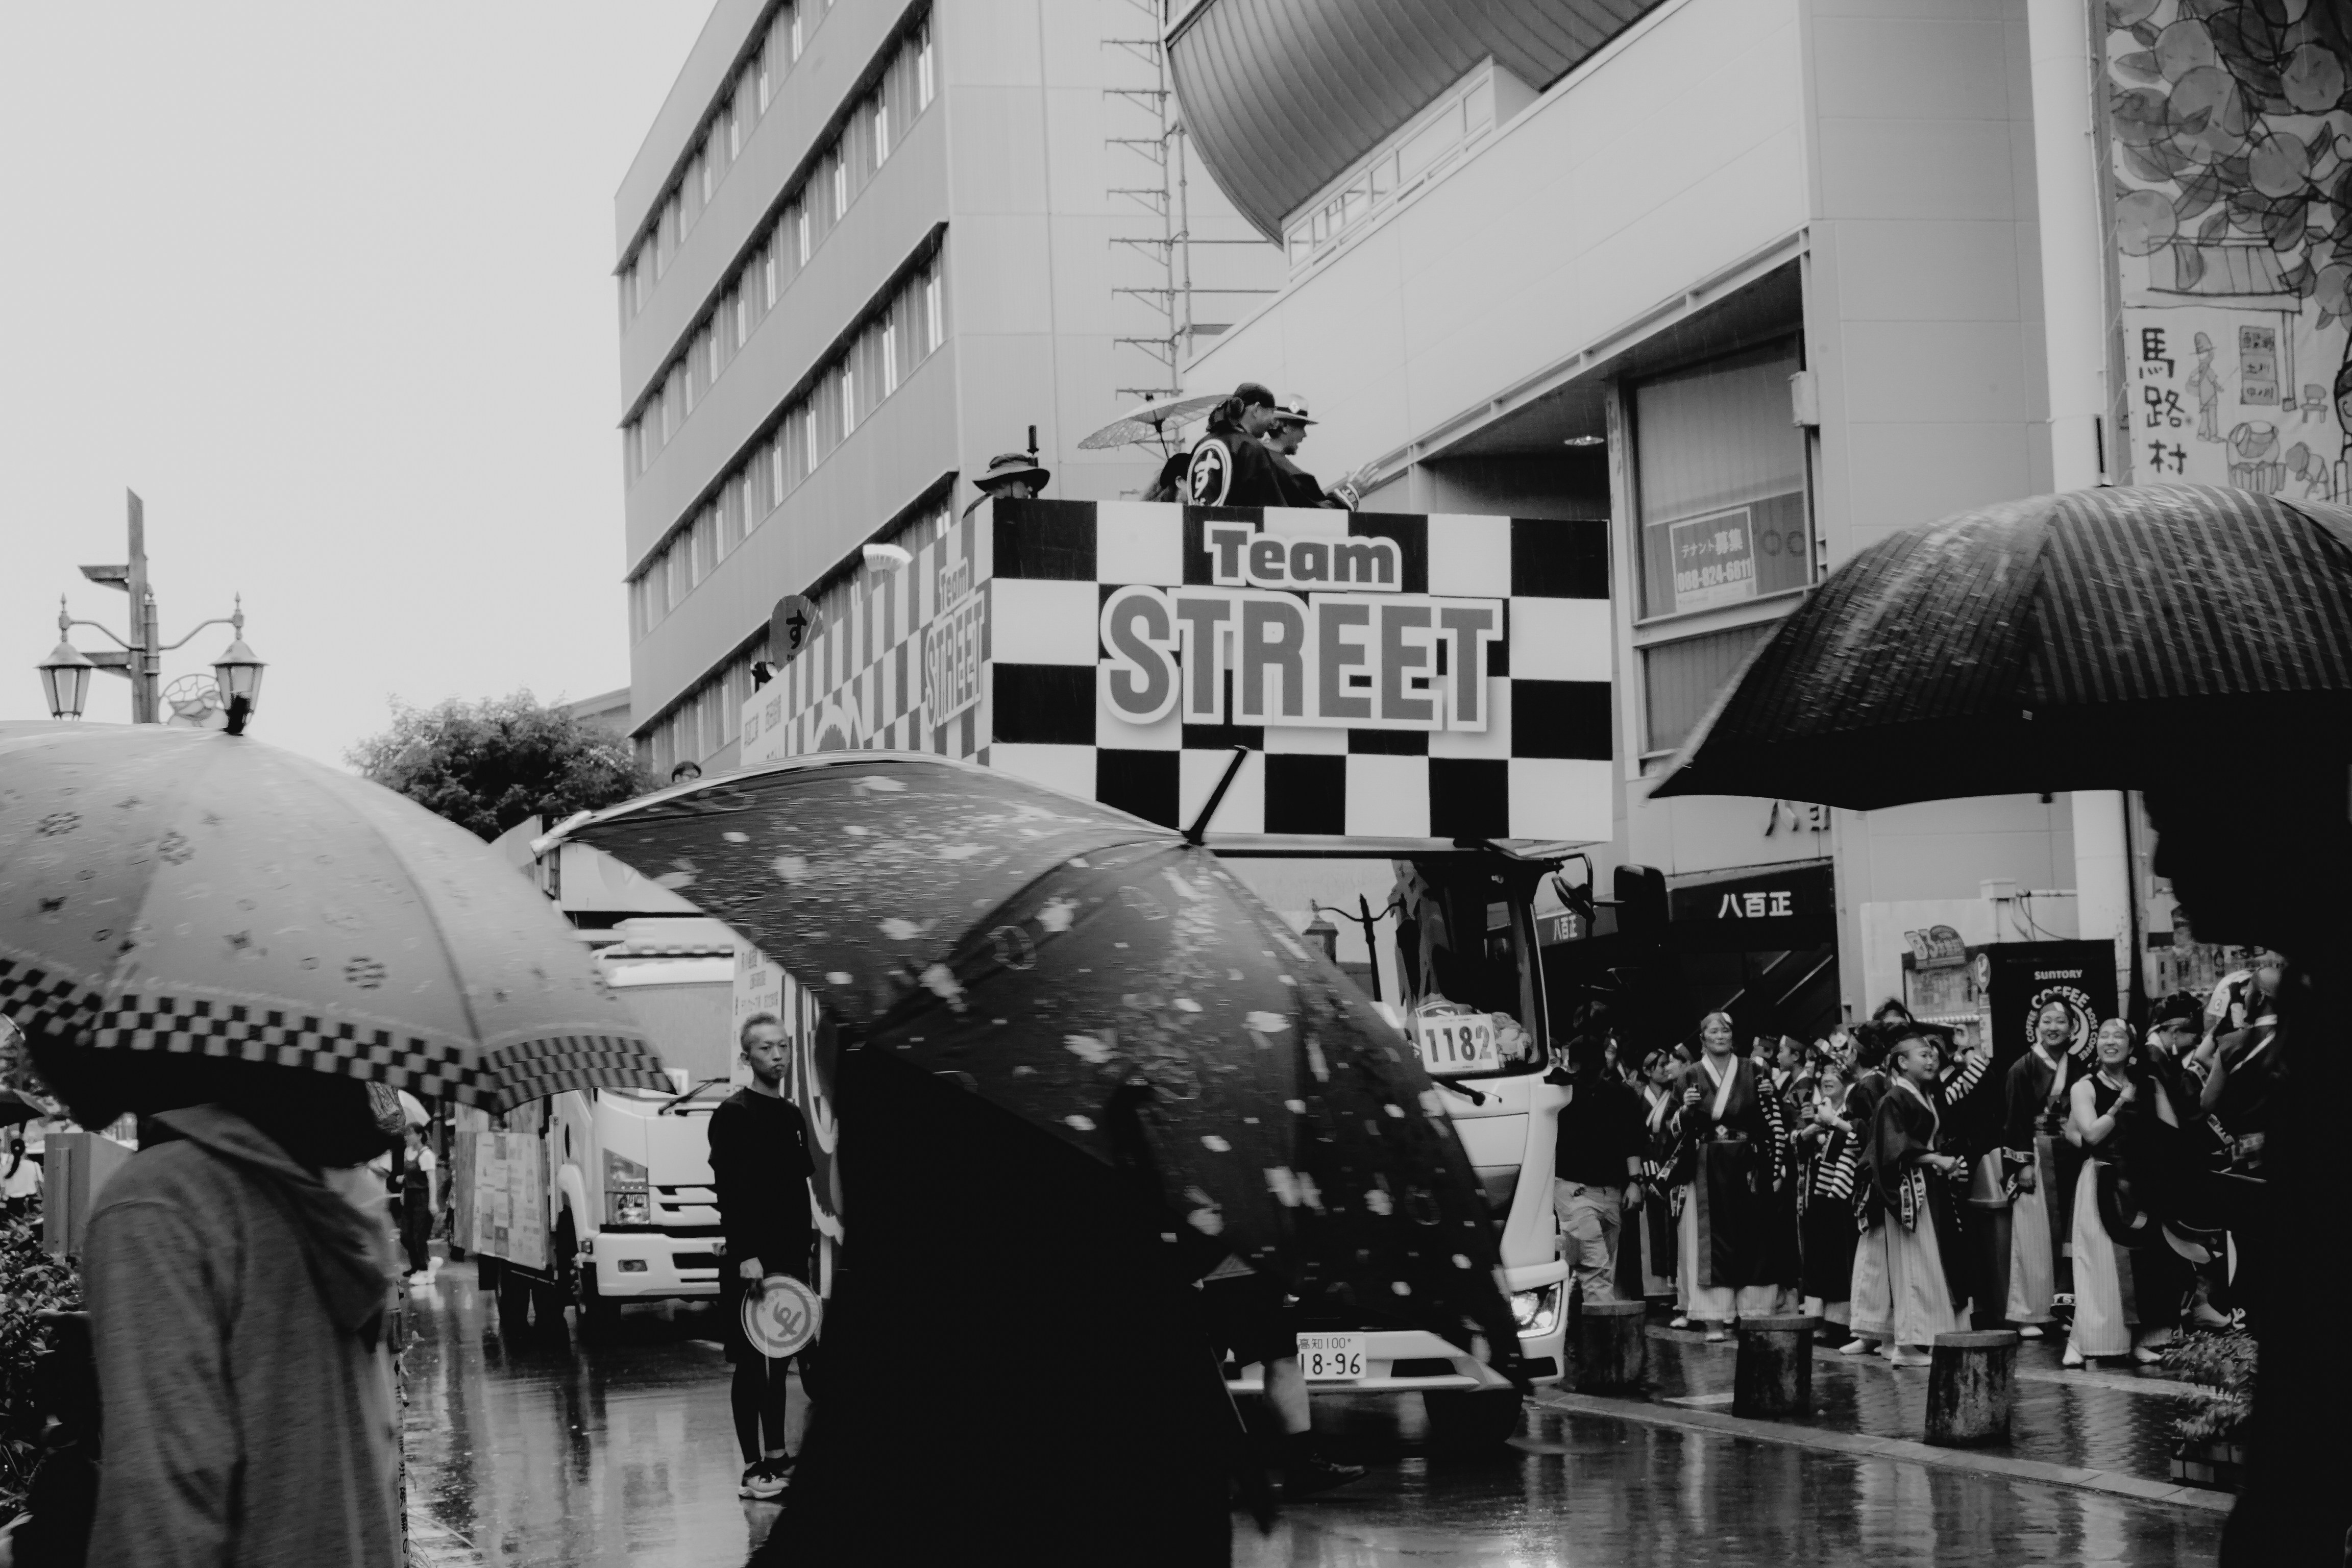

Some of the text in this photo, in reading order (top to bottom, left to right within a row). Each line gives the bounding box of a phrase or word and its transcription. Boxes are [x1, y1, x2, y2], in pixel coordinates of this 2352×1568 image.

[2139, 328, 2186, 475] 馬路村
[1208, 525, 1398, 587] Team
[940, 559, 968, 611] Team
[786, 609, 807, 649] す
[926, 595, 983, 730] STREET
[1105, 589, 1498, 727] STREET
[1718, 891, 1793, 918] 八百正
[1553, 915, 1578, 940] 八百正
[1425, 1025, 1492, 1063] 1182
[1298, 1337, 1345, 1350] 高知 100
[1301, 1353, 1361, 1375] 18-96
